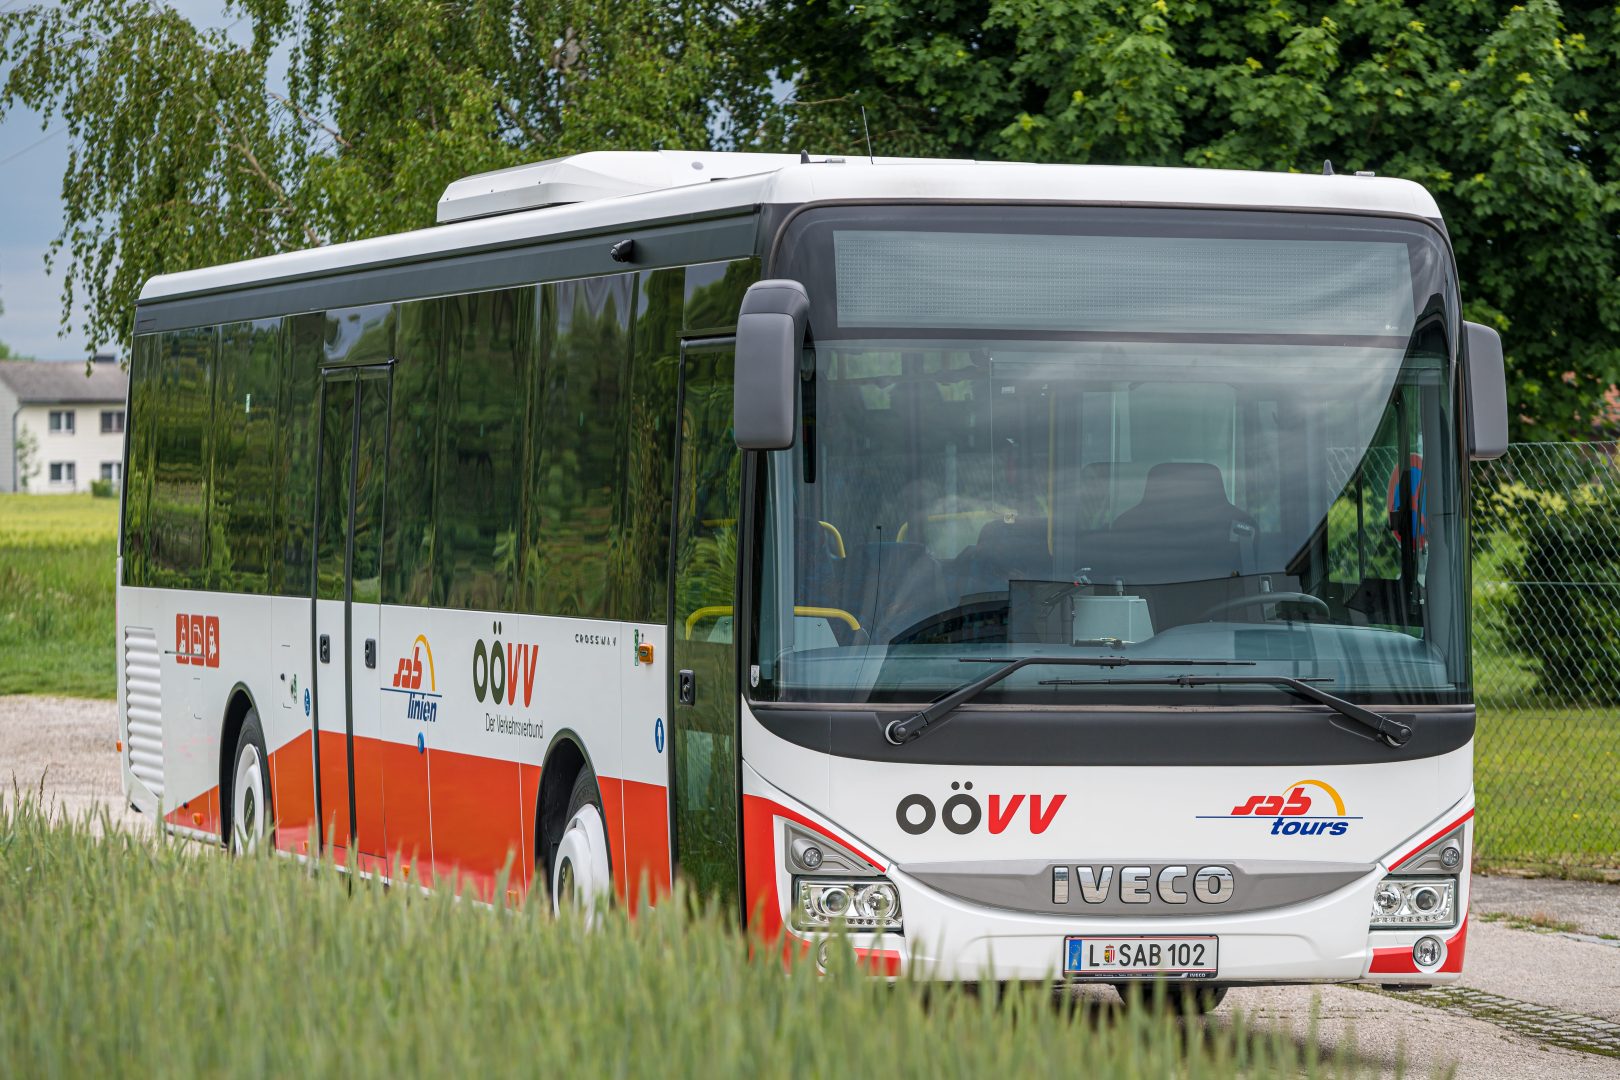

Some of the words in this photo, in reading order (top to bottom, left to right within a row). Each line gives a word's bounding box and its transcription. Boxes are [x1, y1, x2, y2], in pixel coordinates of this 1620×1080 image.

[392, 646, 423, 690] sab
[407, 692, 437, 722] linien
[485, 713, 495, 733] Der
[496, 714, 544, 739] Verkehrsverbund
[1230, 787, 1312, 816] sab
[1270, 817, 1349, 836] tours
[1052, 866, 1234, 905] IVECO
[1071, 958, 1078, 967] A
[1089, 944, 1100, 967] L
[1118, 943, 1162, 967] SAB
[1167, 943, 1206, 967] 102
